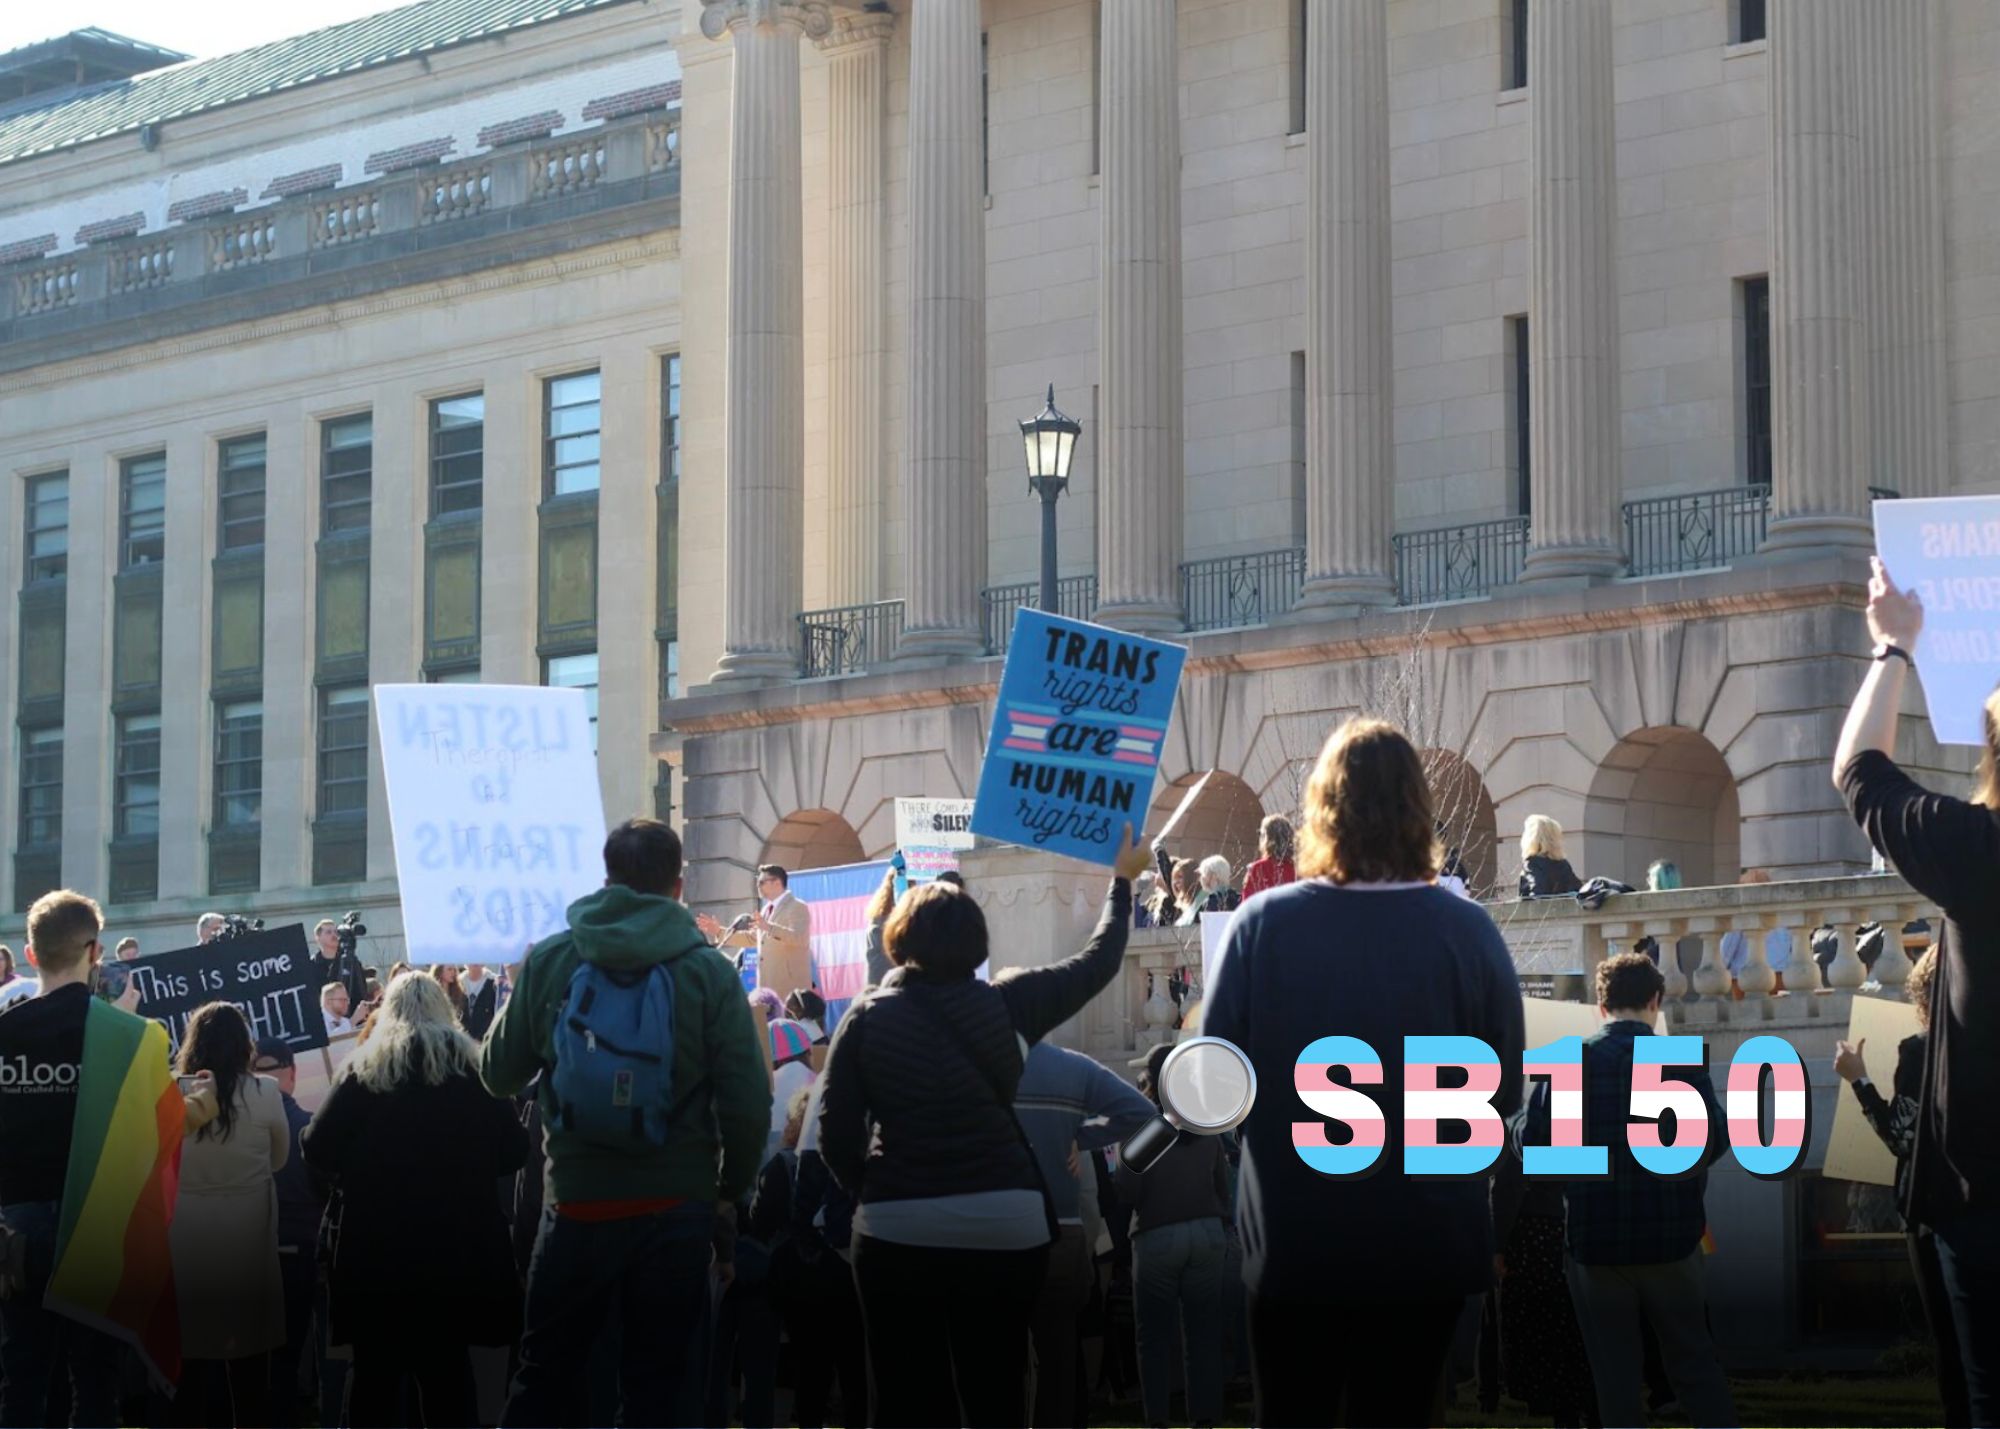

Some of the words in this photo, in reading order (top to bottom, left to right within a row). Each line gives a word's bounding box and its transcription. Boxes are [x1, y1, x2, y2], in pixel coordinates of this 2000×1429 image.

[1046, 625, 1161, 684] TRANS
[1043, 668, 1140, 716] rights
[1047, 718, 1120, 756] are
[1010, 762, 1135, 812] HUMAN
[932, 813, 972, 832] SILEN
[1015, 799, 1111, 844] rights
[129, 966, 189, 1004] This
[198, 968, 224, 991] is
[237, 953, 293, 983] some
[0, 1054, 82, 1085] bloo
